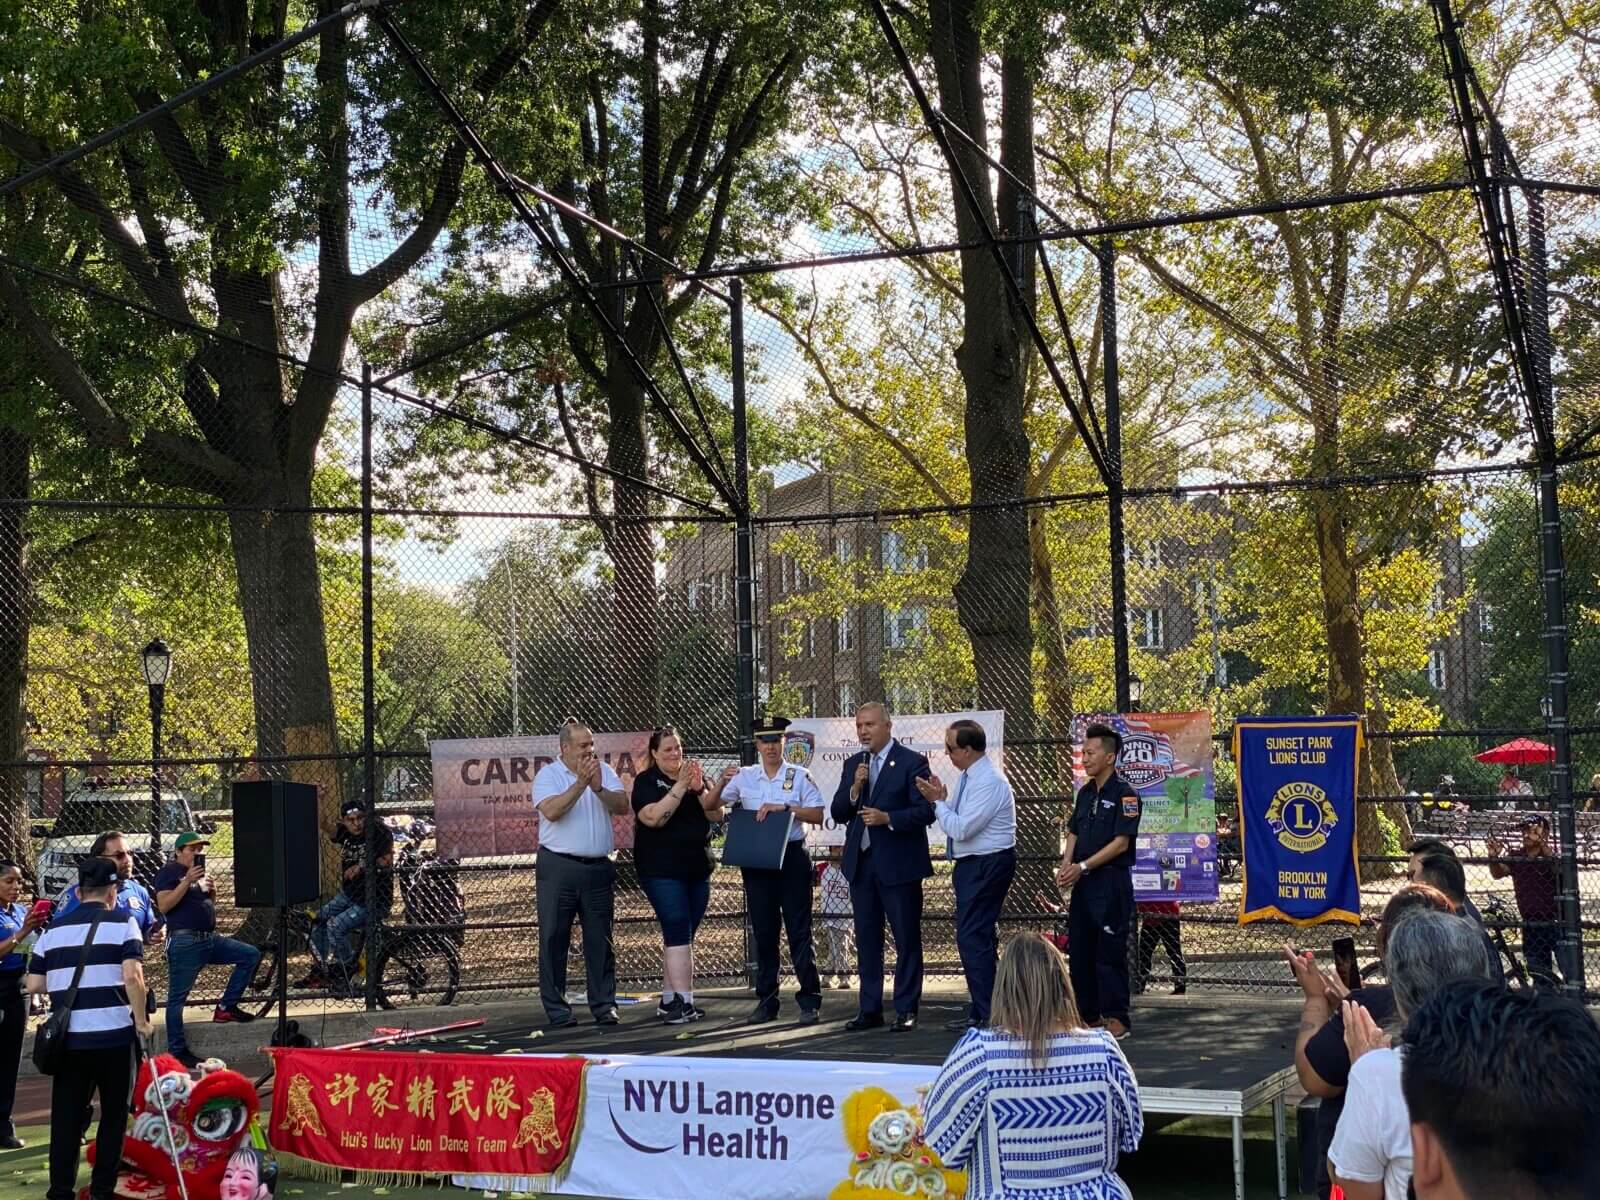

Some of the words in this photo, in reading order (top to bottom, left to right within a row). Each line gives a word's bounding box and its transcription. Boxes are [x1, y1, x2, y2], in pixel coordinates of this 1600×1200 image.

[1123, 741, 1152, 752] NNO
[1266, 736, 1305, 750] SUNSET
[1308, 736, 1333, 749] PARK
[1122, 749, 1153, 763] 40
[1269, 751, 1298, 765] LIONS
[1300, 751, 1326, 764] CLUB
[1281, 783, 1324, 801] LIONS
[483, 795, 501, 804] TAX
[1294, 803, 1313, 829] L
[1280, 835, 1323, 849] INTERNATIONAL
[1278, 870, 1328, 884] BROOKLYN
[1278, 886, 1300, 899] NEW
[1303, 886, 1327, 899] YORK
[325, 1072, 521, 1122] 許家精武隊
[623, 1079, 690, 1114] NYU
[696, 1081, 835, 1125] Langone
[340, 1130, 368, 1149] Hui's
[374, 1134, 404, 1155] lucky
[410, 1134, 432, 1152] Lion
[440, 1135, 469, 1153] Dance
[476, 1136, 507, 1153] Team
[682, 1123, 788, 1160] Health
